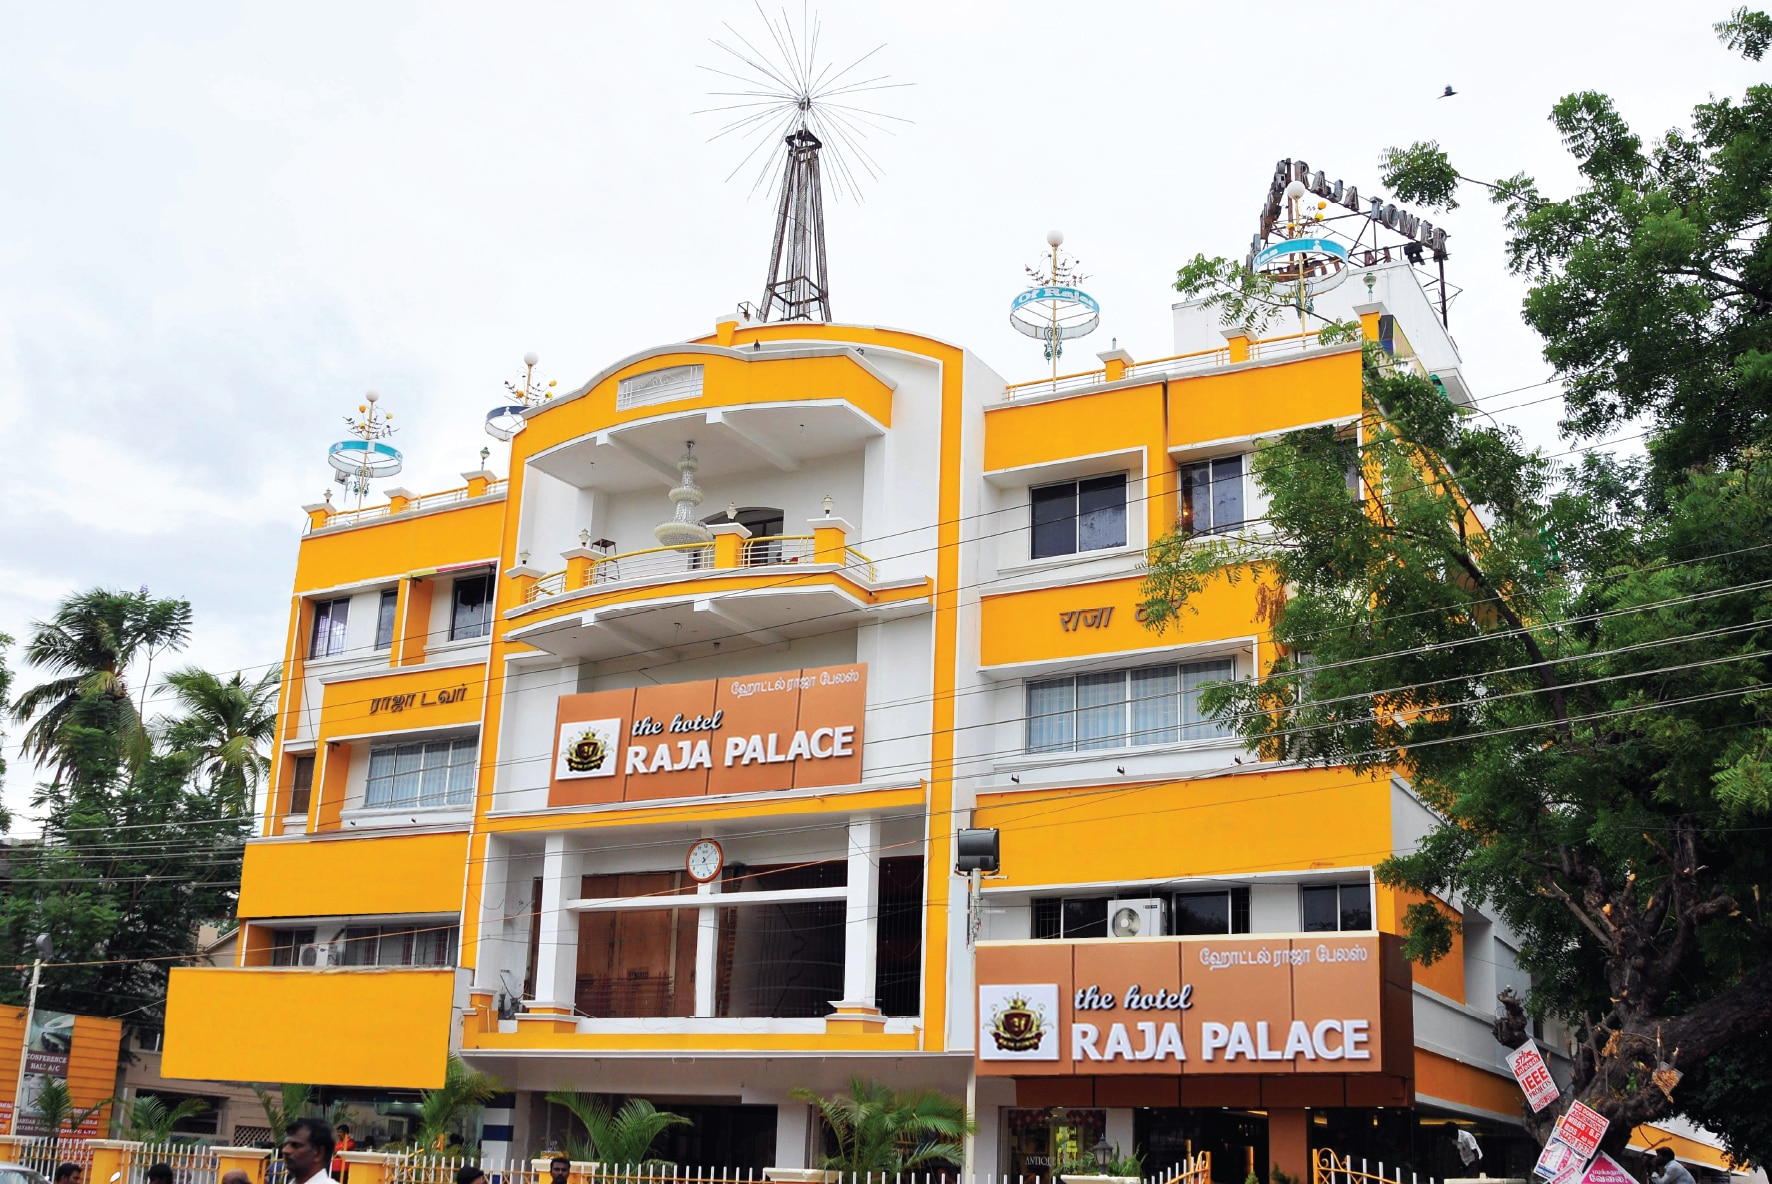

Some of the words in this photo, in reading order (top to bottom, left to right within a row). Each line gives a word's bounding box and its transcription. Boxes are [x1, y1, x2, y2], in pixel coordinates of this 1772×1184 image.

[1294, 160, 1360, 211] RAJA
[1370, 196, 1449, 261] TOWER
[1059, 605, 1115, 632] राजा
[787, 676, 816, 692] ராஜா
[369, 692, 416, 715] ராஜா
[420, 683, 467, 706] டவர்
[632, 716, 663, 736] the
[669, 710, 724, 732] hotel
[625, 740, 713, 775] RAJA
[724, 726, 855, 767] PALACE
[1273, 949, 1310, 967] ராஜா
[1074, 986, 1116, 1010] the
[1124, 984, 1193, 1010] hotel
[1072, 1022, 1187, 1061] RAJA
[1202, 1019, 1371, 1061] PALACE
[26, 1053, 67, 1063] CONFERENCE
[48, 1064, 60, 1072] A/C
[1521, 1065, 1549, 1093] IEEE
